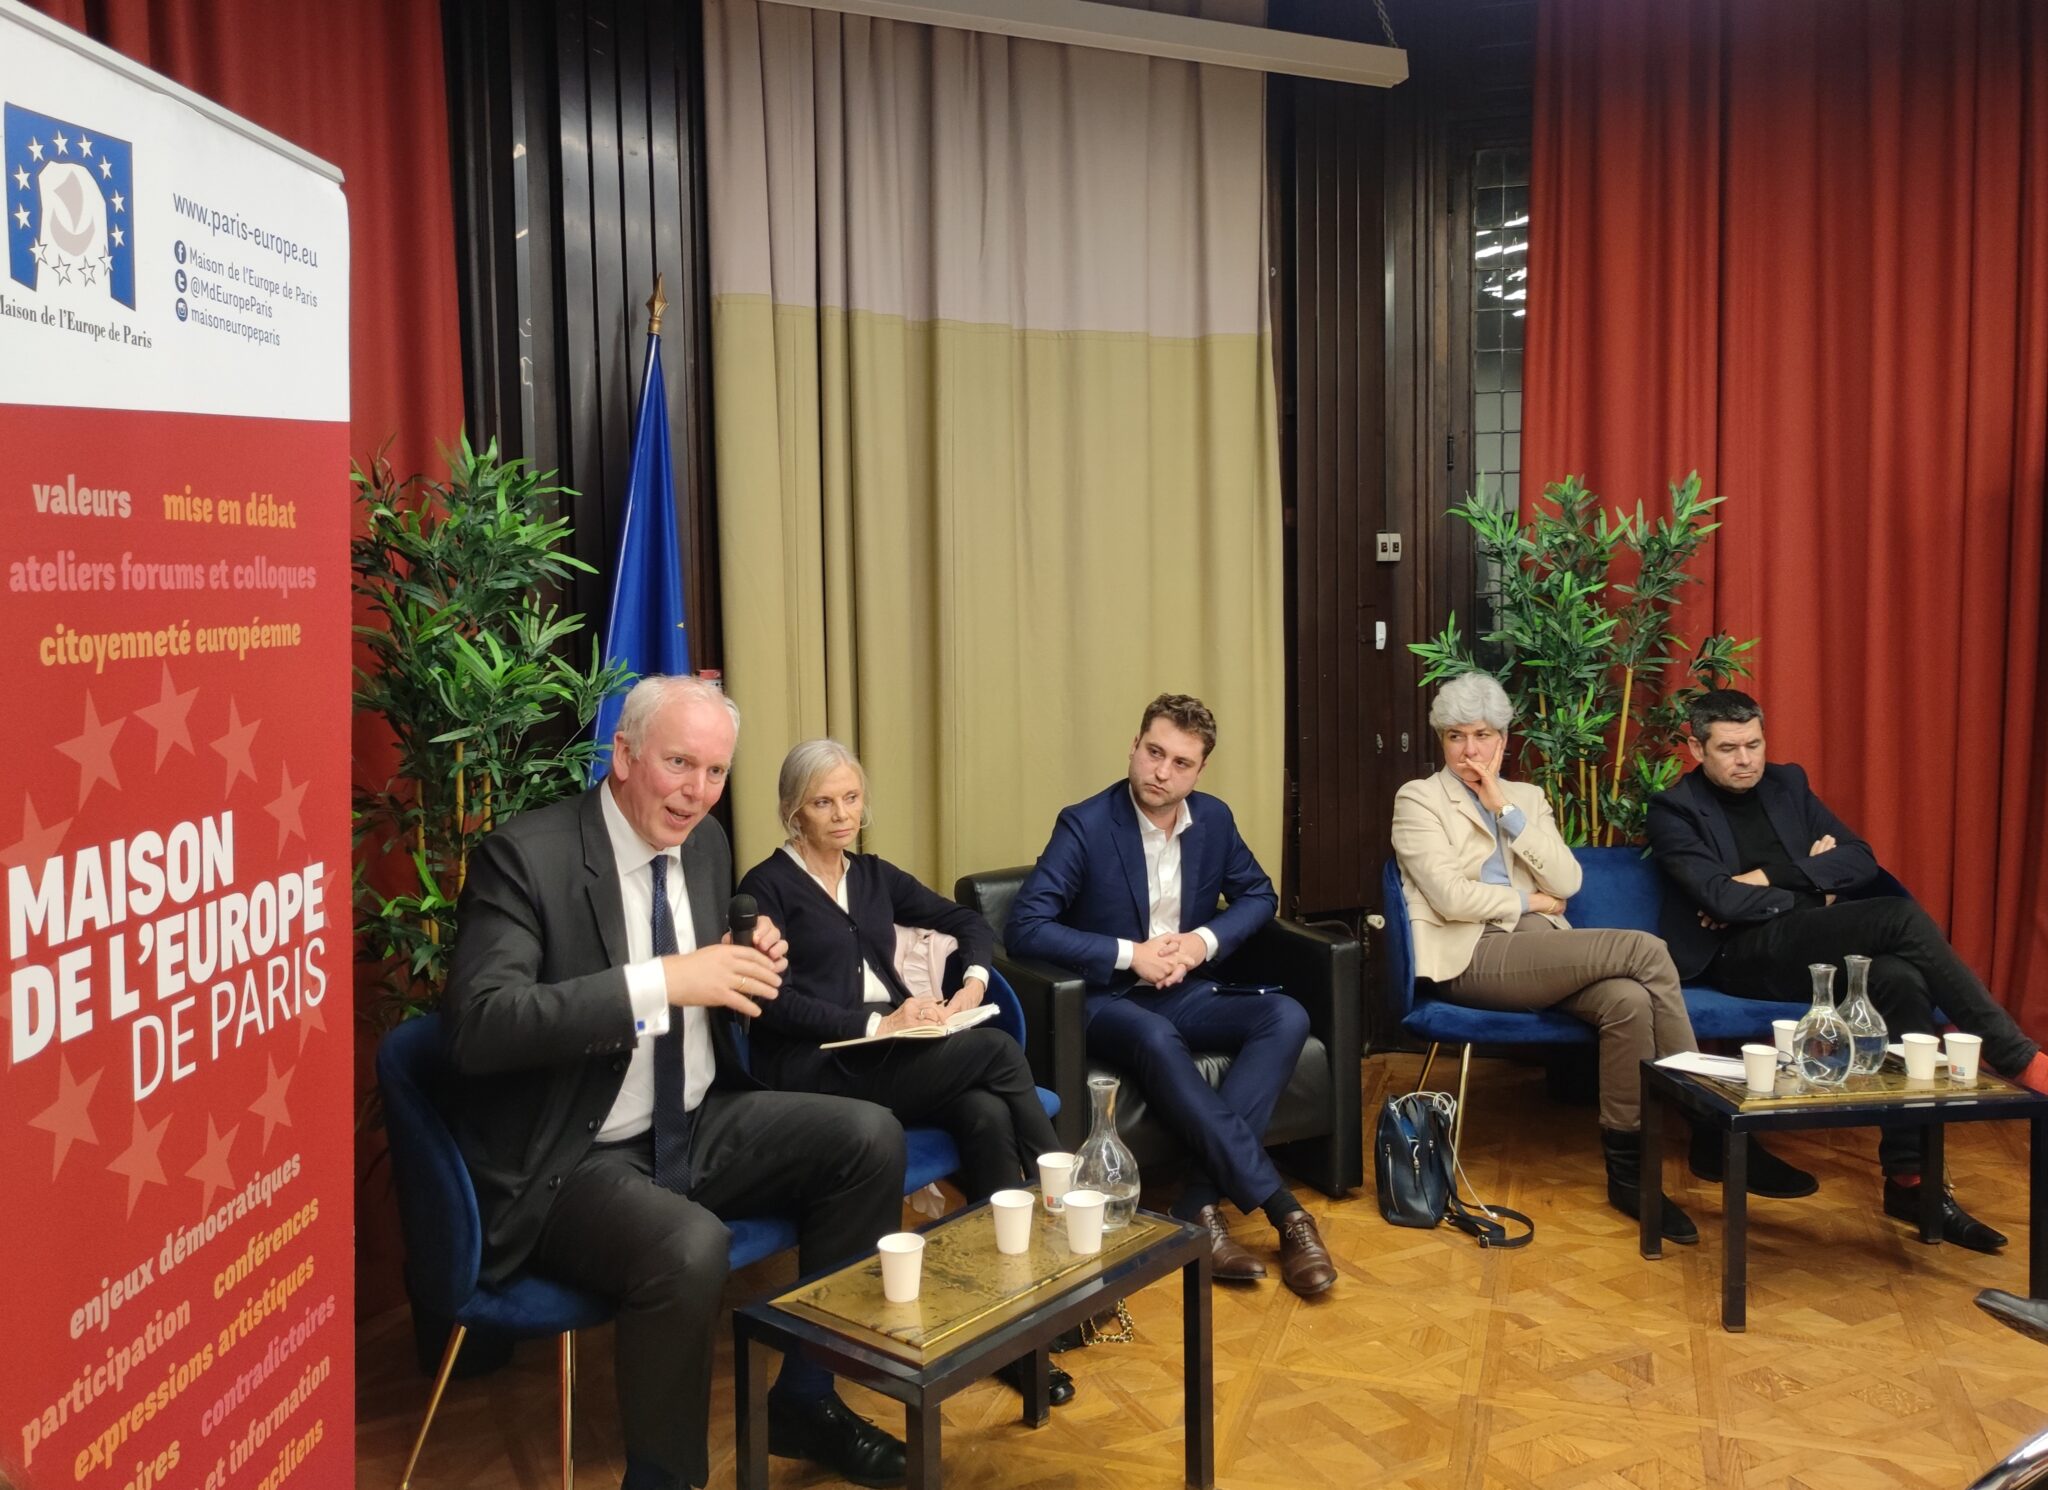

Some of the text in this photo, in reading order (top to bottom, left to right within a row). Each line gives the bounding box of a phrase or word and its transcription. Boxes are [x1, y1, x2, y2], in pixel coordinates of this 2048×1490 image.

[172, 192, 318, 268] www.paris-europe.eu
[189, 247, 318, 307] Maison de l'Europe de Paris
[190, 276, 273, 318] @MdEuropeParis
[40, 305, 56, 326] de
[59, 309, 107, 342] l'Europe
[108, 322, 121, 341] de
[123, 325, 153, 348] Paris
[191, 308, 281, 346] maisoneuropeparis
[32, 474, 132, 518] valeurs
[163, 484, 296, 529] mise en débat
[9, 550, 317, 599] ateliers forums et colloques
[40, 616, 301, 674] citoyenneté européenne
[8, 810, 234, 960] MAISON
[11, 862, 324, 1065] DE L'EUROPE
[132, 938, 327, 1102] DE PARIS
[70, 1153, 301, 1340] enjeux démocratiques
[213, 1198, 319, 1300] conférences
[22, 1300, 190, 1469] participation
[75, 1255, 314, 1482] expressions artistiques
[201, 1295, 335, 1437] contradictoires
[205, 1356, 330, 1490] et information
